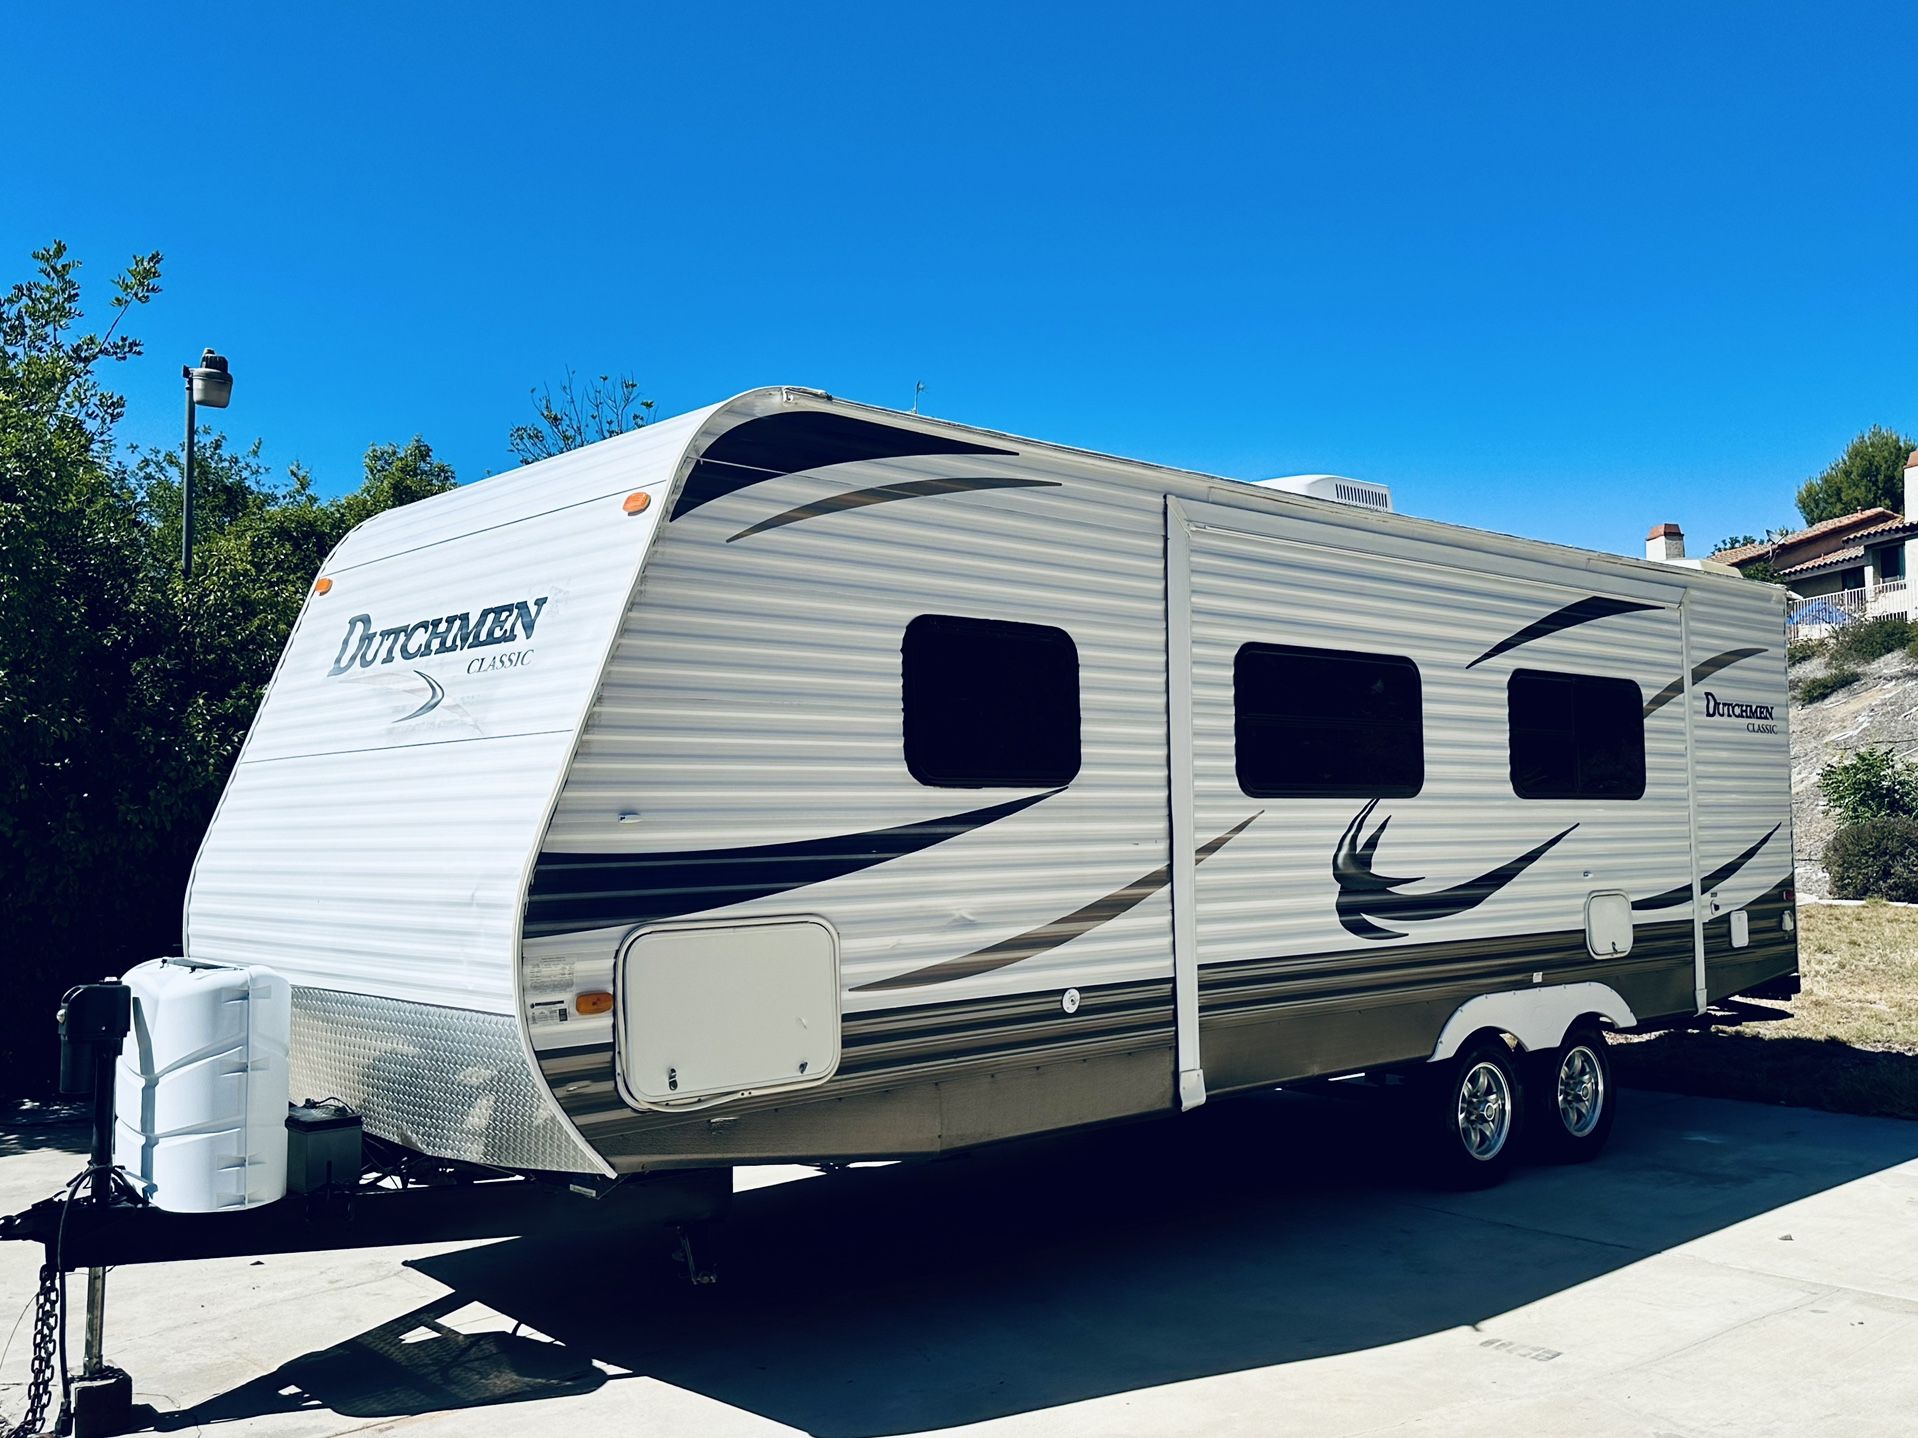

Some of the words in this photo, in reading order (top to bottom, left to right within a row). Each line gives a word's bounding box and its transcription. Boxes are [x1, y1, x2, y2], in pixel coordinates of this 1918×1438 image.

[327, 596, 548, 677] DUTCHMEN
[467, 649, 535, 675] CLASSIC
[1704, 691, 1774, 721] DUTCHMEN
[1746, 722, 1778, 735] CLASSIC
